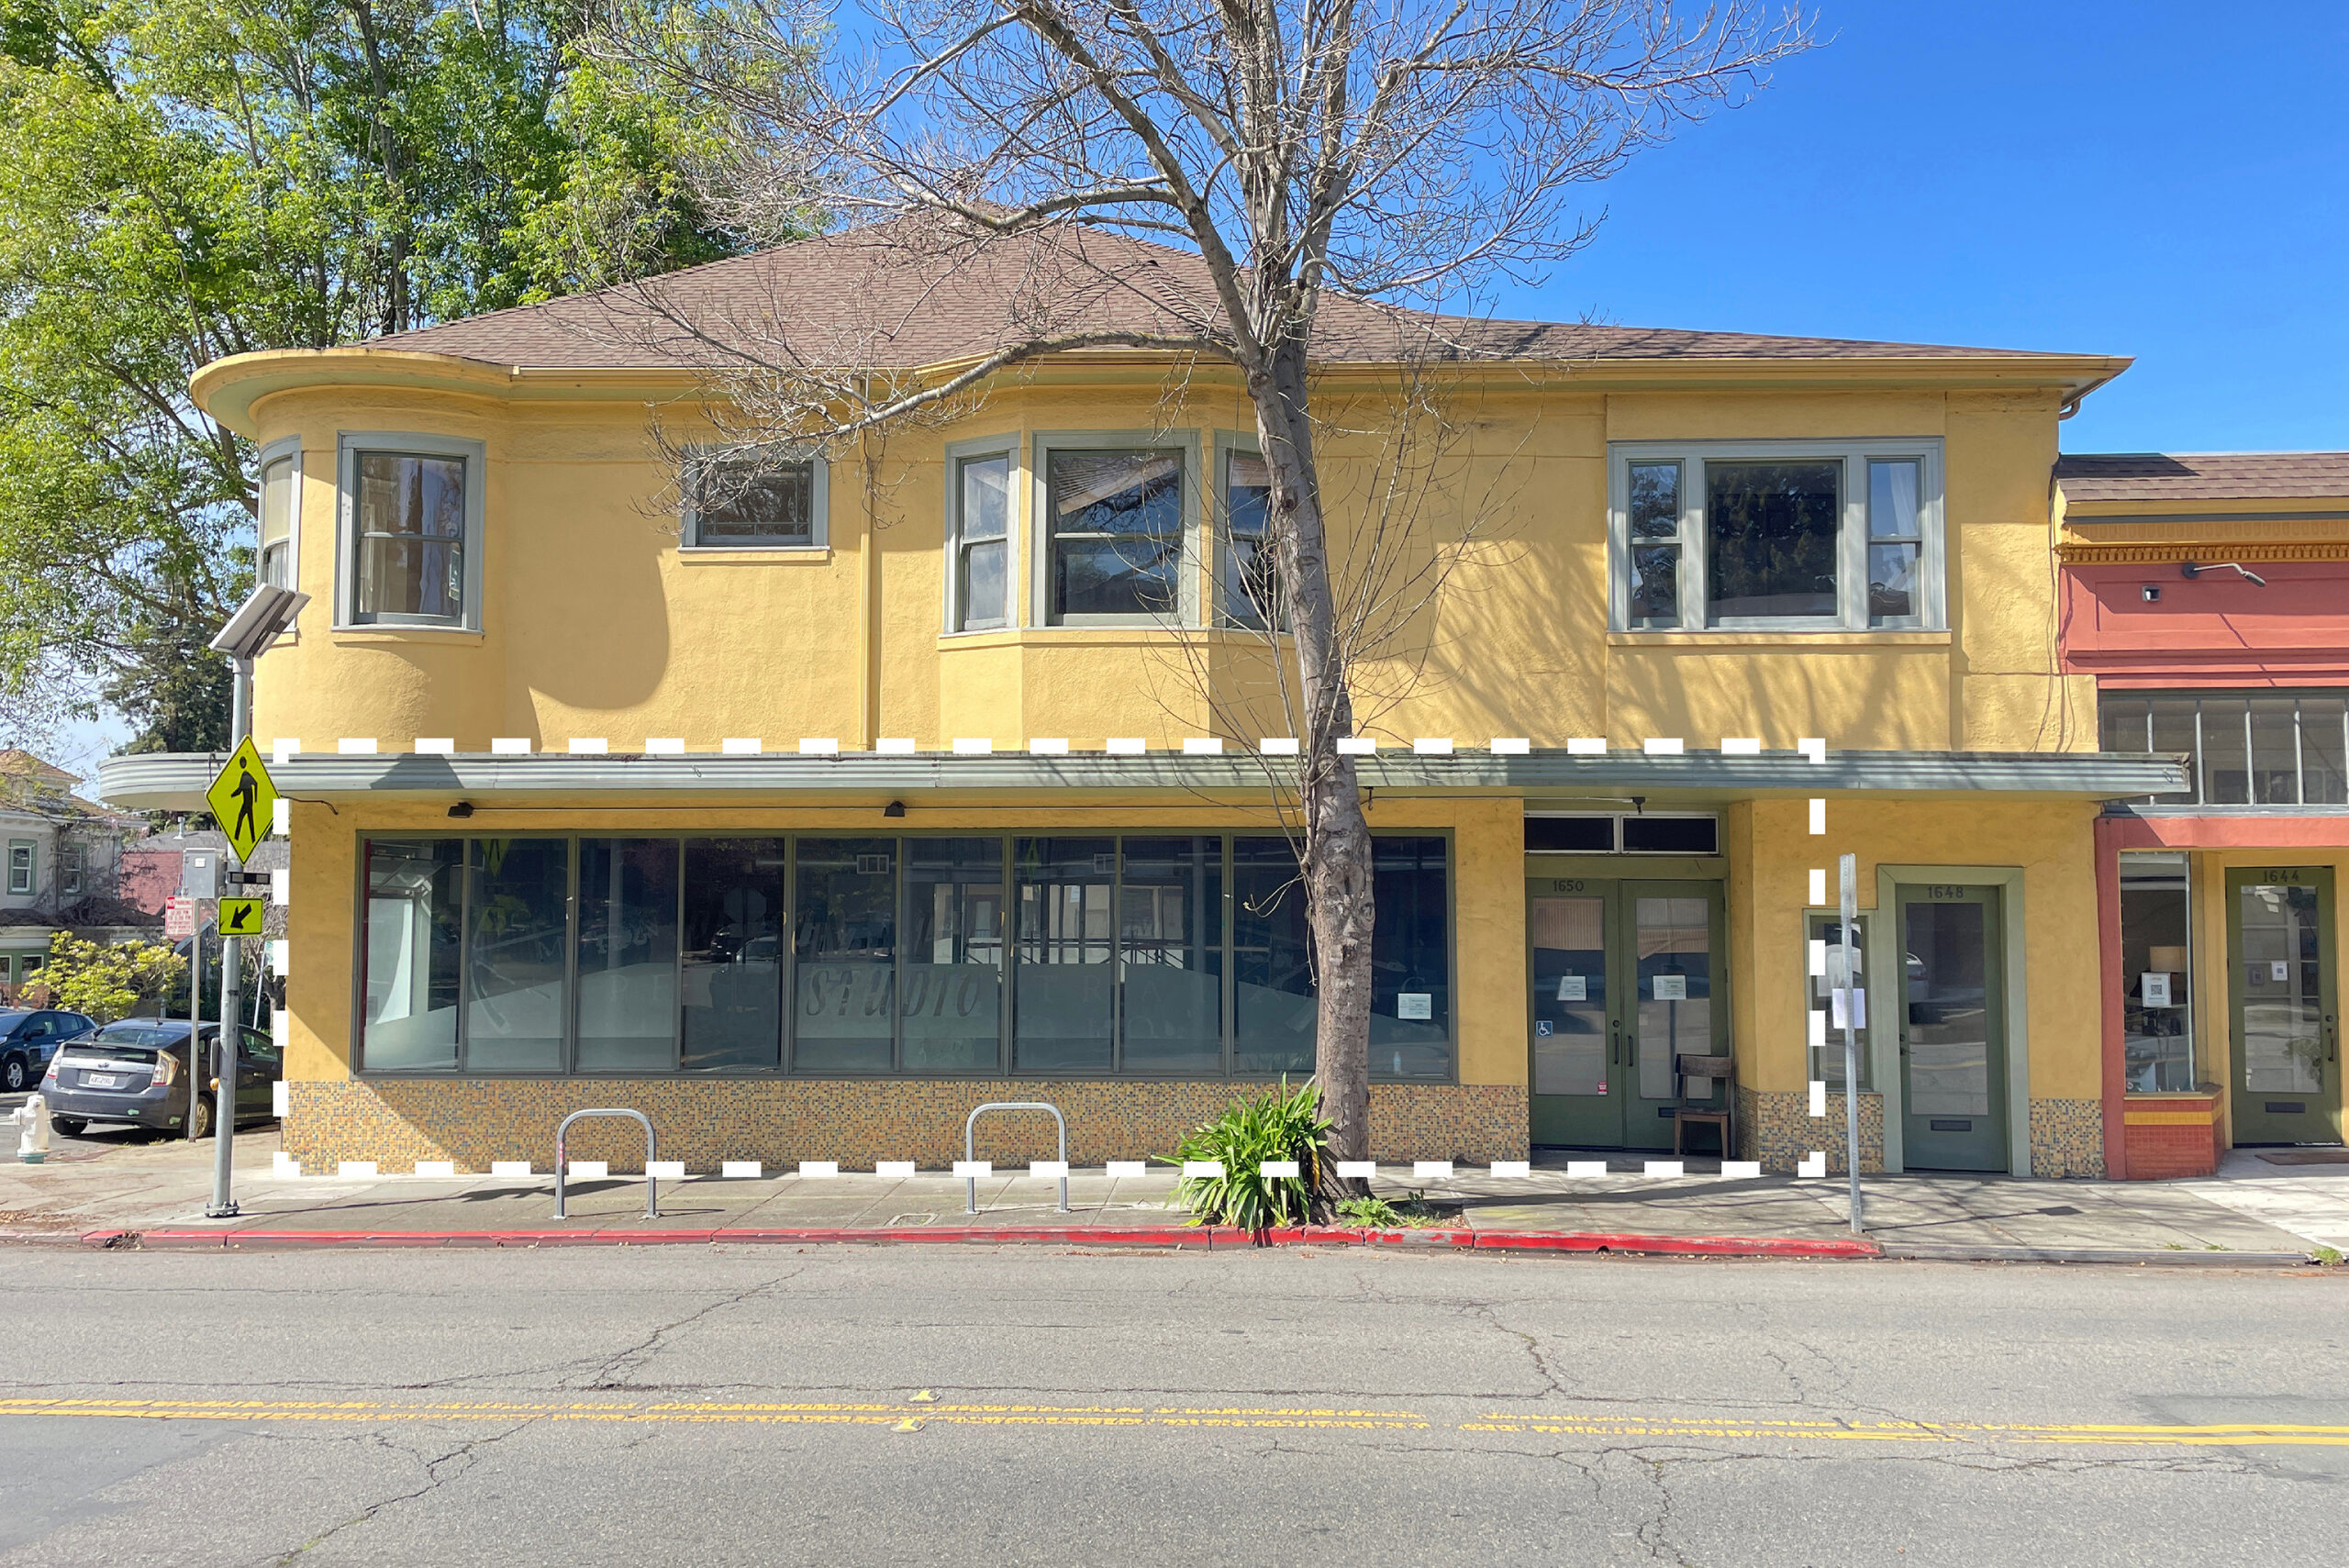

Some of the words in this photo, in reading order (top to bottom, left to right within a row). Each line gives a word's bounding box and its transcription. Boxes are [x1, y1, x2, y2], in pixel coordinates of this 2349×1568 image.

[2263, 870, 2299, 883] 1644
[1553, 879, 1585, 892] 1650
[1928, 885, 1964, 899] 1648
[807, 970, 981, 1017] STUDIO
